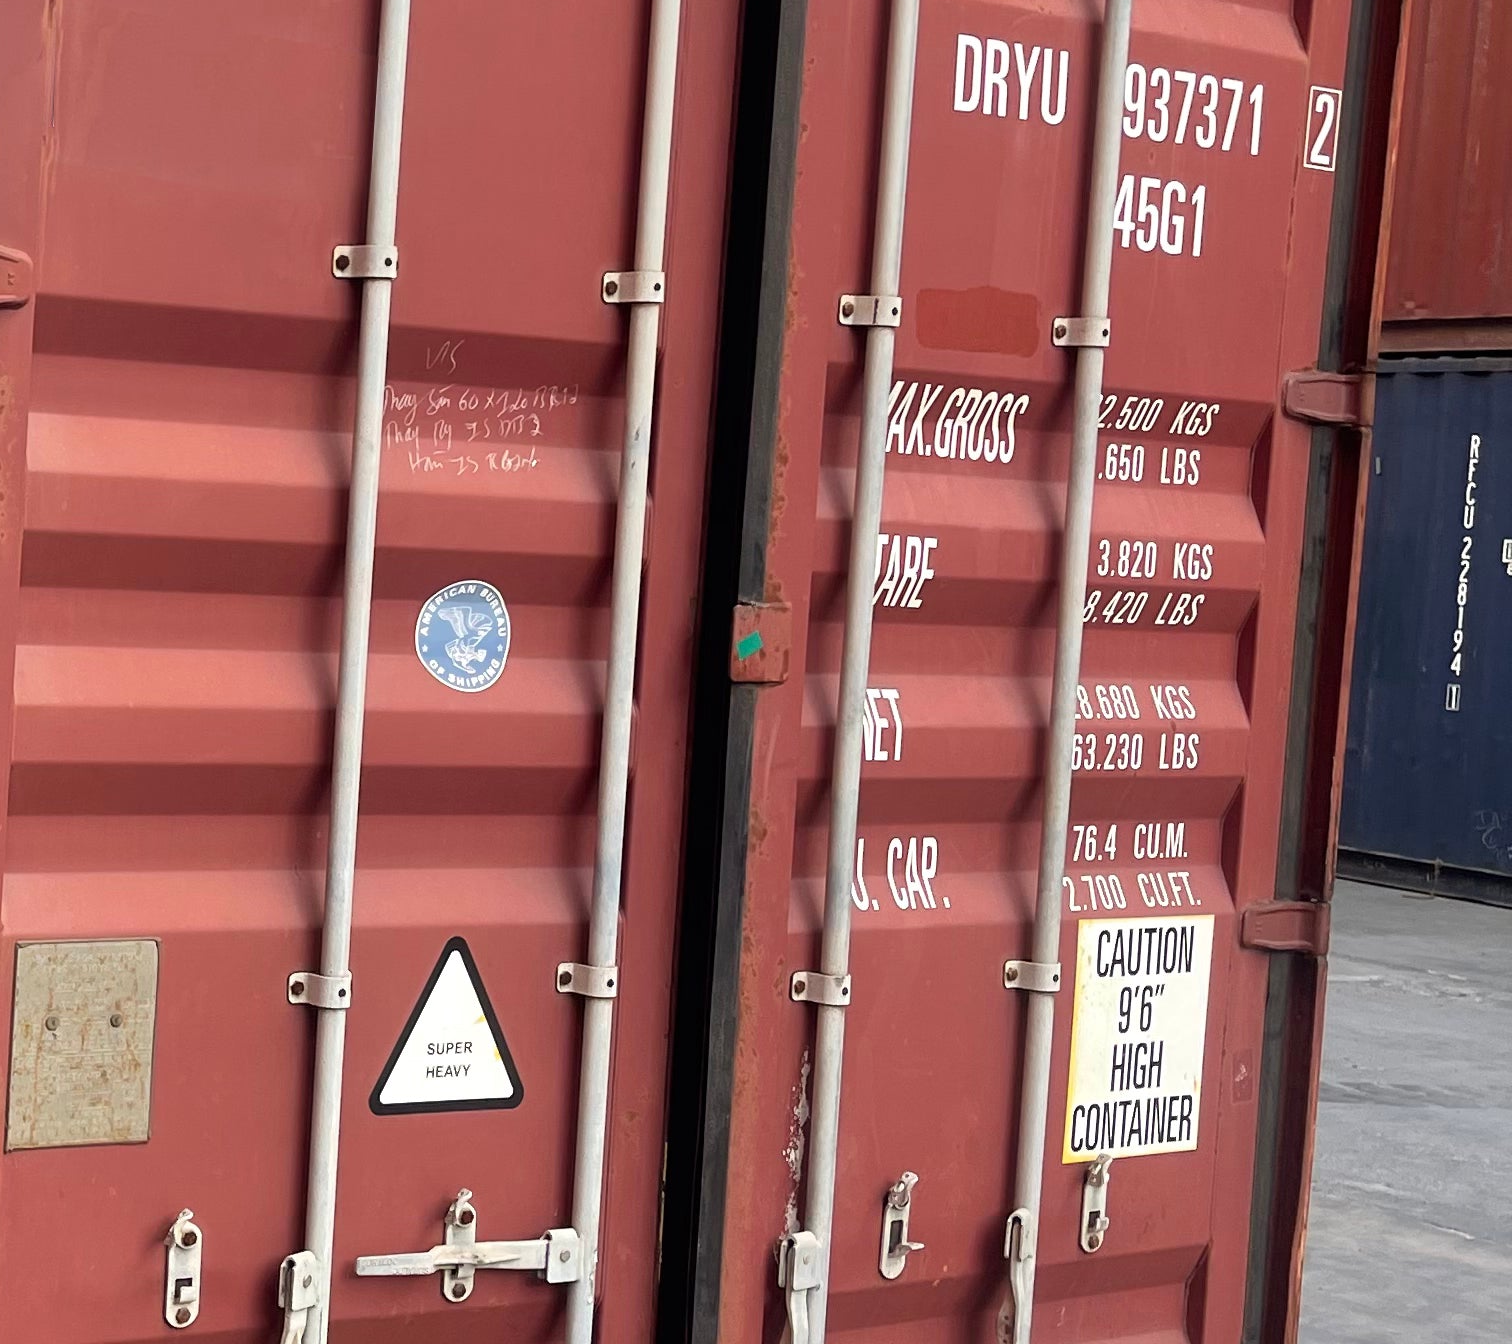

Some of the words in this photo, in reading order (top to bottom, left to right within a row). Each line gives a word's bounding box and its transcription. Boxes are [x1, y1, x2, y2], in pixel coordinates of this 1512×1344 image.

[954, 33, 1070, 126] DRYU
[1122, 63, 1265, 157] 937371
[1310, 93, 1336, 166] 2
[1113, 174, 1207, 257] 45G1
[1096, 393, 1165, 432] 2.500
[1169, 401, 1220, 437] KGS
[1160, 447, 1201, 486] LBS
[1463, 434, 1481, 530] RFCU
[1097, 539, 1158, 580] 3.820
[1173, 542, 1214, 582] KGS
[420, 584, 478, 637] AMERICAN
[479, 587, 507, 637] BUREAU
[1154, 592, 1206, 626] LBS
[1450, 536, 1473, 677] 228194
[429, 659, 446, 675] OF
[447, 658, 501, 688] SHIPPING
[1074, 684, 1141, 720] 8.680
[1149, 684, 1197, 721] KGS
[1158, 732, 1200, 771] LBS
[1072, 823, 1118, 863] 76.4
[1133, 821, 1189, 861] CU.M.
[1062, 874, 1128, 913] 2.700
[1137, 871, 1202, 909] CU.FT.
[1096, 924, 1196, 979] CAUTION
[426, 1040, 473, 1056] SUPER
[1110, 1040, 1164, 1093] HIGH
[425, 1063, 471, 1079] HEAVY
[1071, 1094, 1194, 1154] CONTAINER
